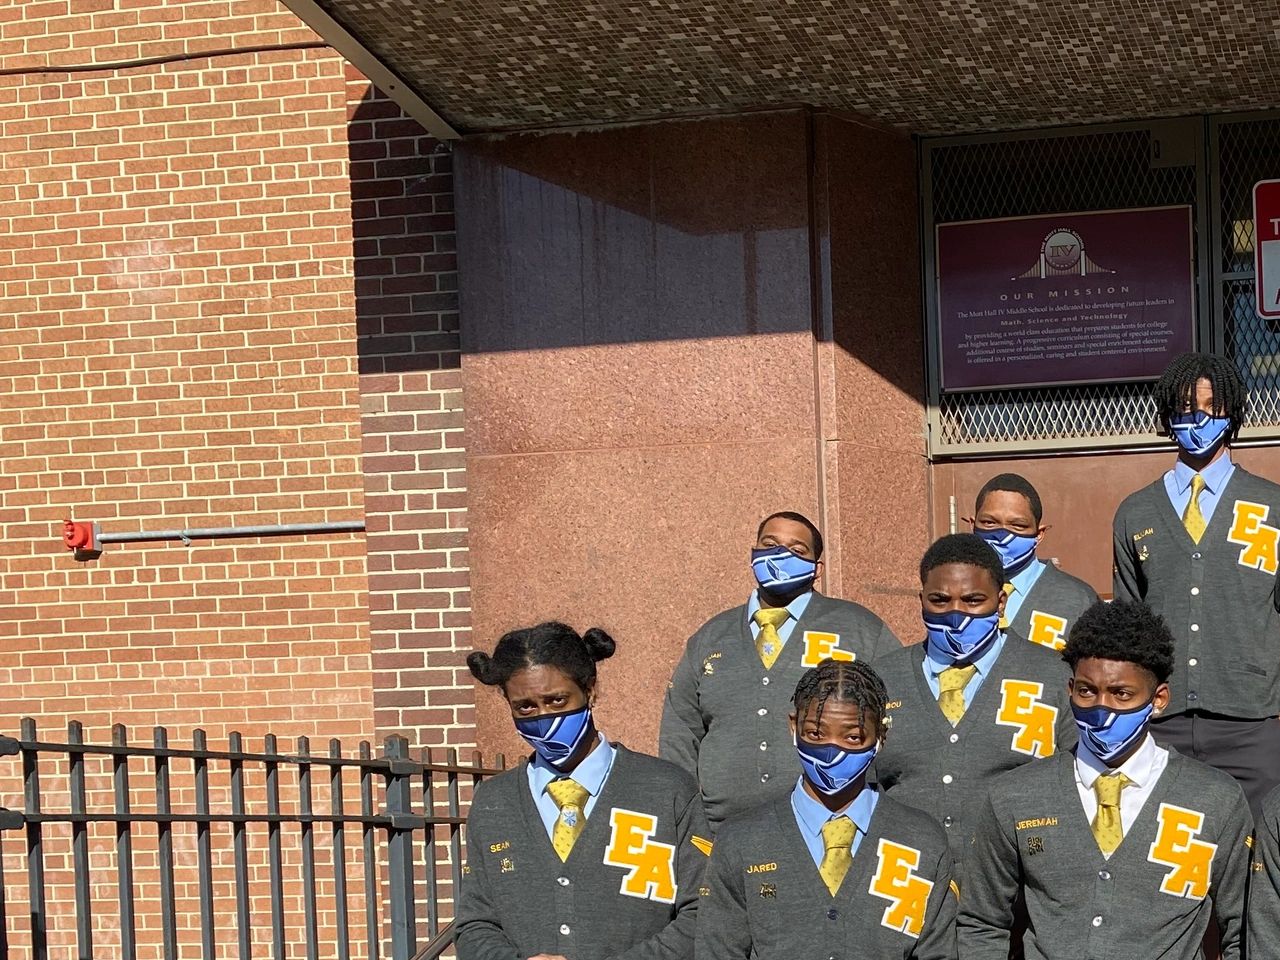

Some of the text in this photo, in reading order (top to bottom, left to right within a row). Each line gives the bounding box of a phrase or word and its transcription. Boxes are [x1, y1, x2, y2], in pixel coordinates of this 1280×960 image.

[1049, 244, 1076, 258] IV
[1000, 286, 1129, 301] OUR MISSION
[957, 311, 969, 319] The
[1027, 306, 1048, 314] School
[1054, 302, 1084, 311] dedicated
[1027, 317, 1058, 325] Science
[1080, 313, 1128, 322] Technology
[1016, 816, 1058, 831] JEREMIAH
[490, 841, 511, 853] SEAN
[747, 861, 778, 874] JARED
